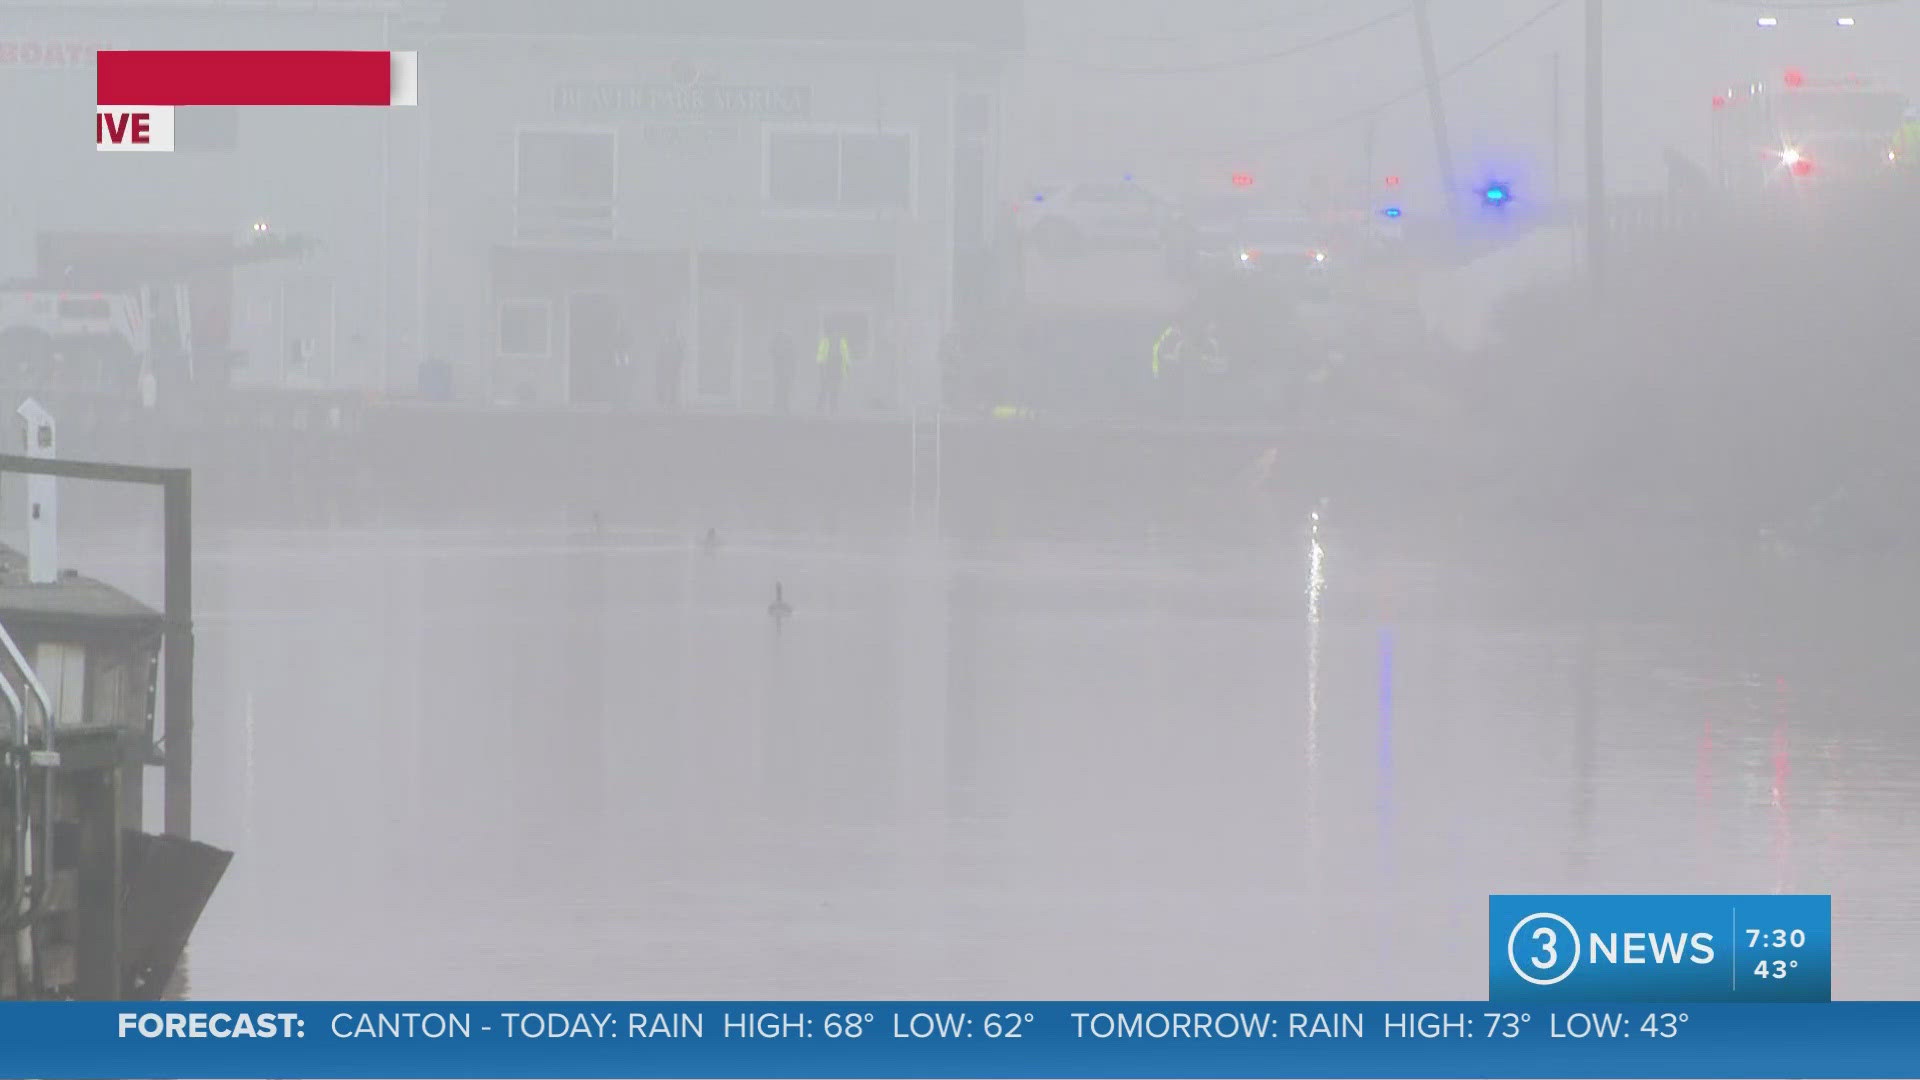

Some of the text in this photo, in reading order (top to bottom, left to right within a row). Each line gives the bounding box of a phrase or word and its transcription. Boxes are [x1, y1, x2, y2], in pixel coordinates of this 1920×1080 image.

[561, 86, 803, 113] BEAVER PARK MARINA
